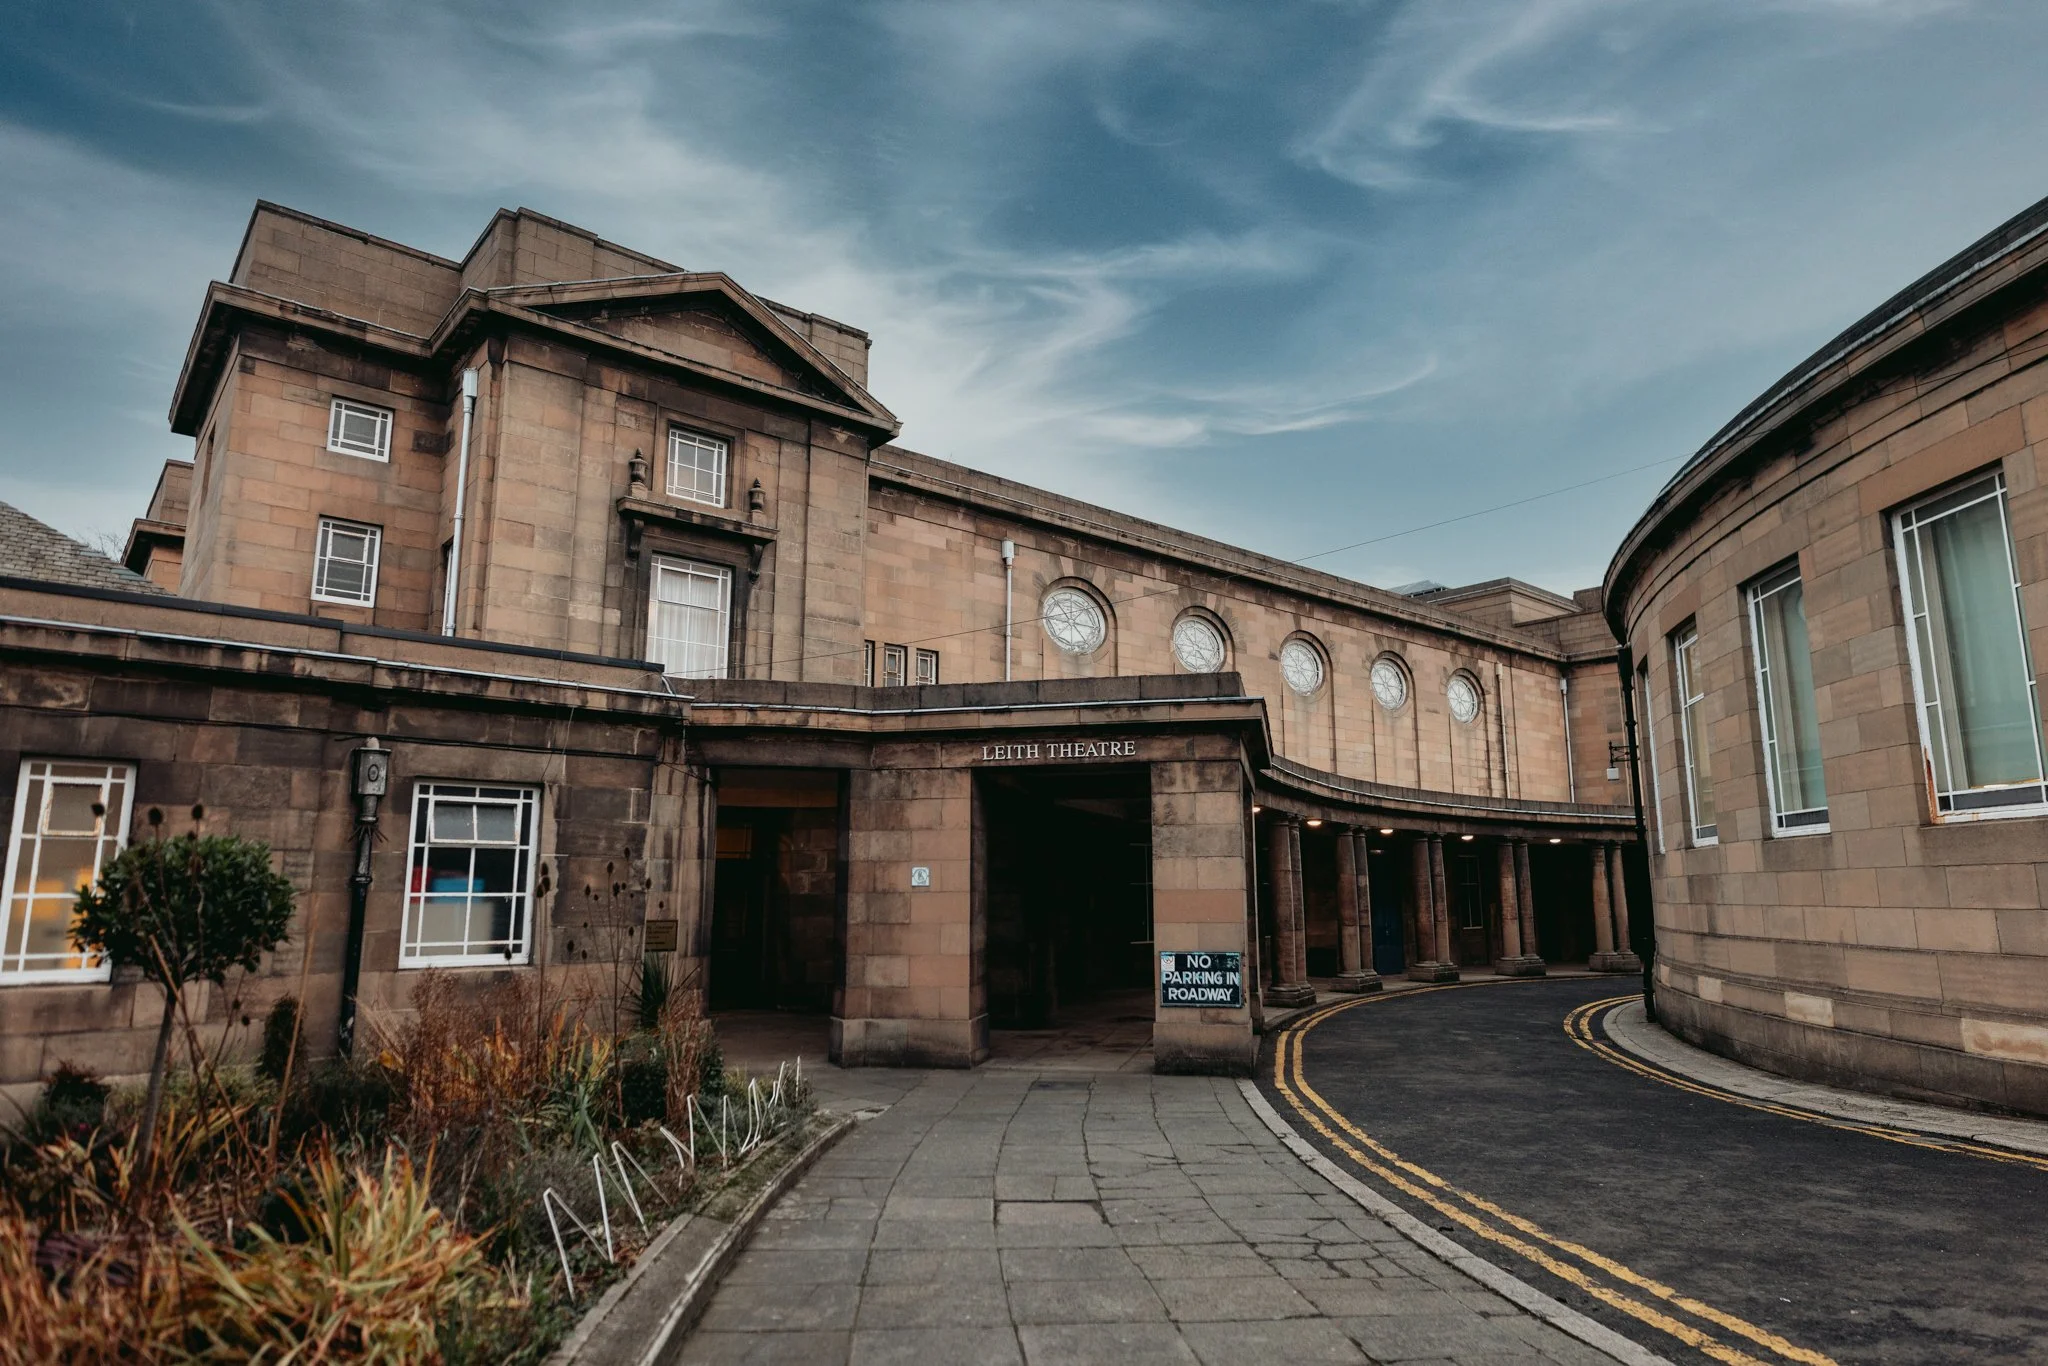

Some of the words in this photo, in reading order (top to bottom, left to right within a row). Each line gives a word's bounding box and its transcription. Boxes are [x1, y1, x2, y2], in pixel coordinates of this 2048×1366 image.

[983, 744, 1040, 761] LEITH
[1046, 741, 1136, 758] THEATRE
[1187, 955, 1212, 969] NO
[1162, 971, 1223, 985] PARKING
[1226, 971, 1240, 985] IN
[1168, 987, 1233, 1001] ROADWAY
